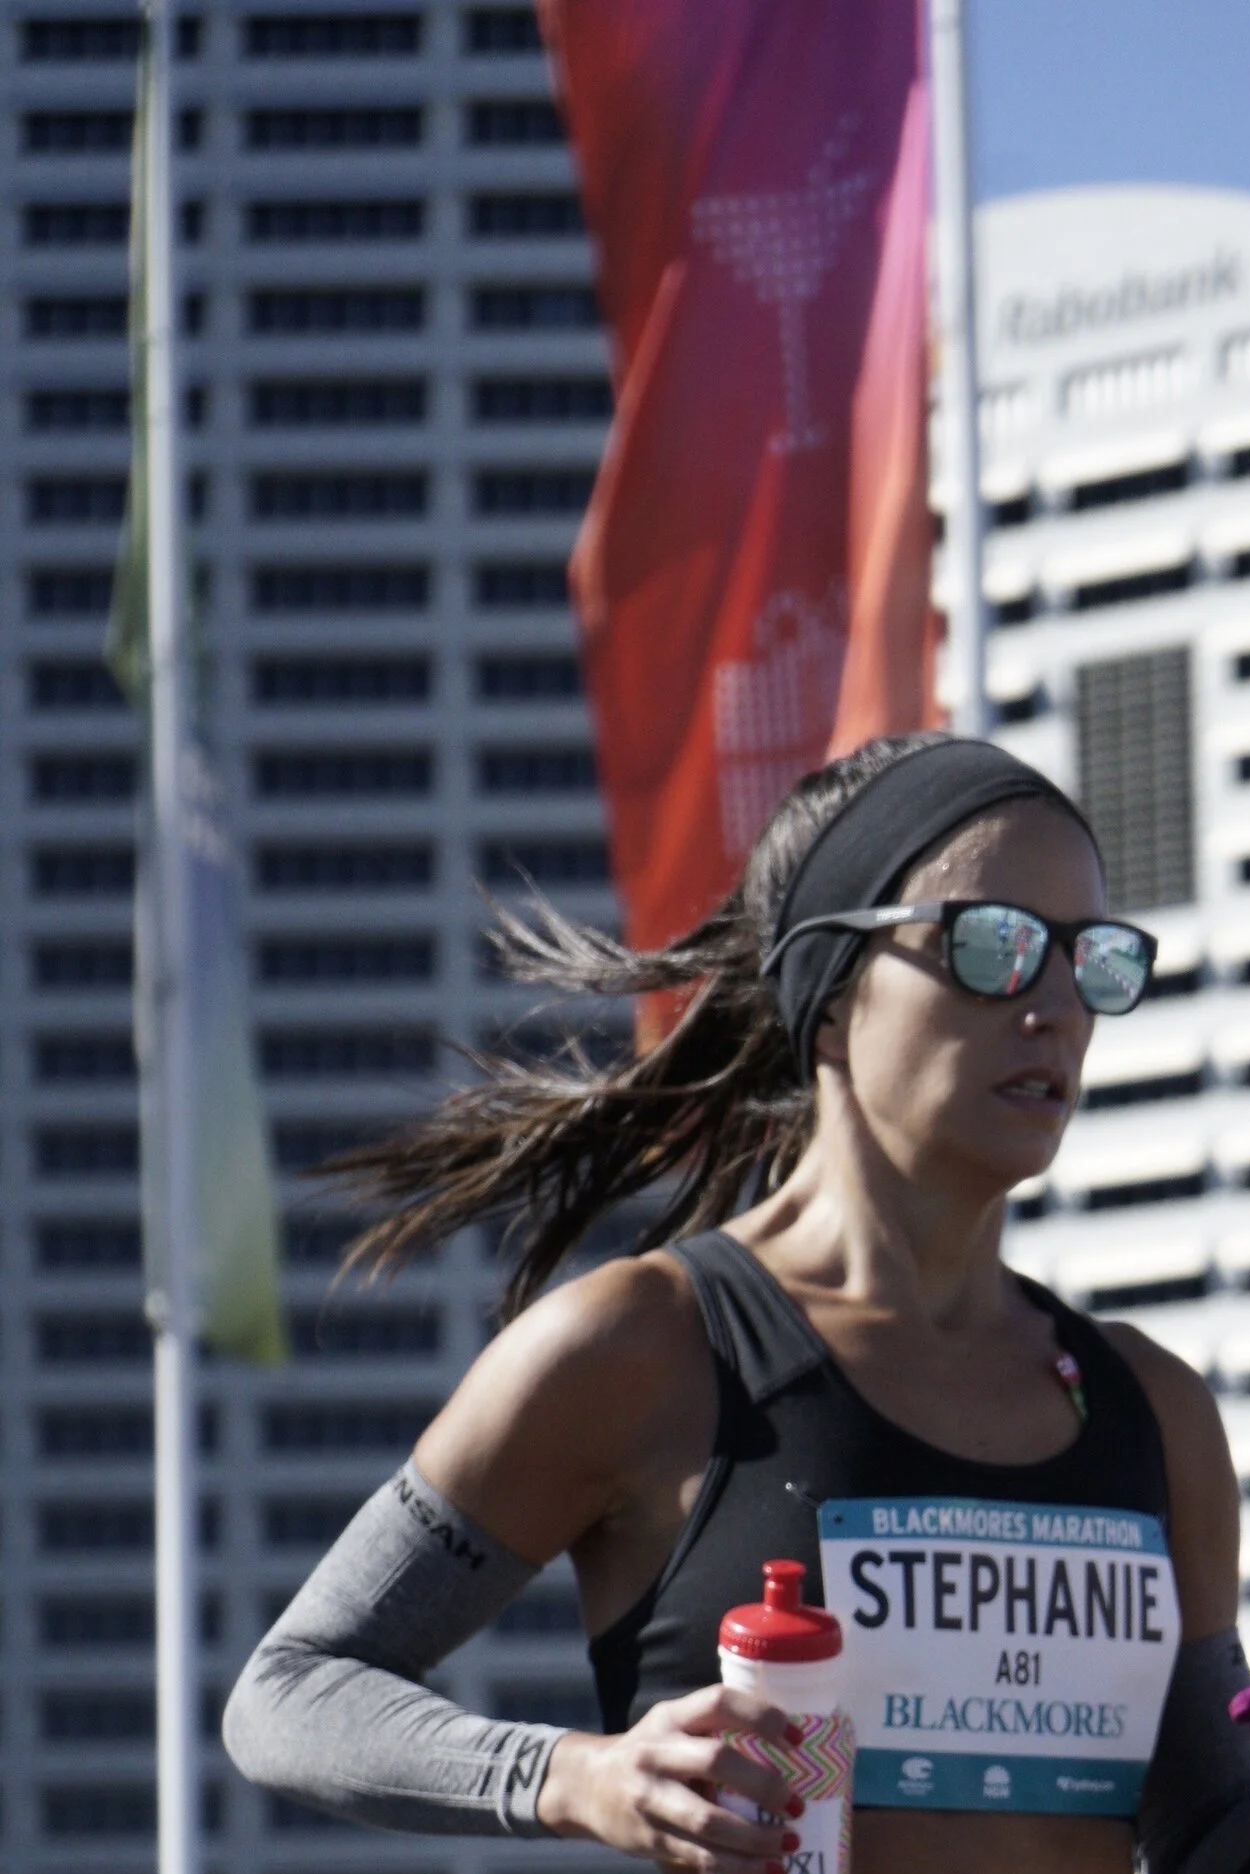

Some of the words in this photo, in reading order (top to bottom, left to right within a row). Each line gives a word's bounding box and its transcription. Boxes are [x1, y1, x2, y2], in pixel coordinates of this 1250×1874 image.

[394, 1476, 485, 1571] NSAH
[872, 1506, 1027, 1540] BLACKMORES
[1031, 1513, 1142, 1548] MARATHON
[850, 1549, 1163, 1643] STEPHANIE
[995, 1650, 1041, 1687] A81
[883, 1692, 1128, 1740] BLACKMORES
